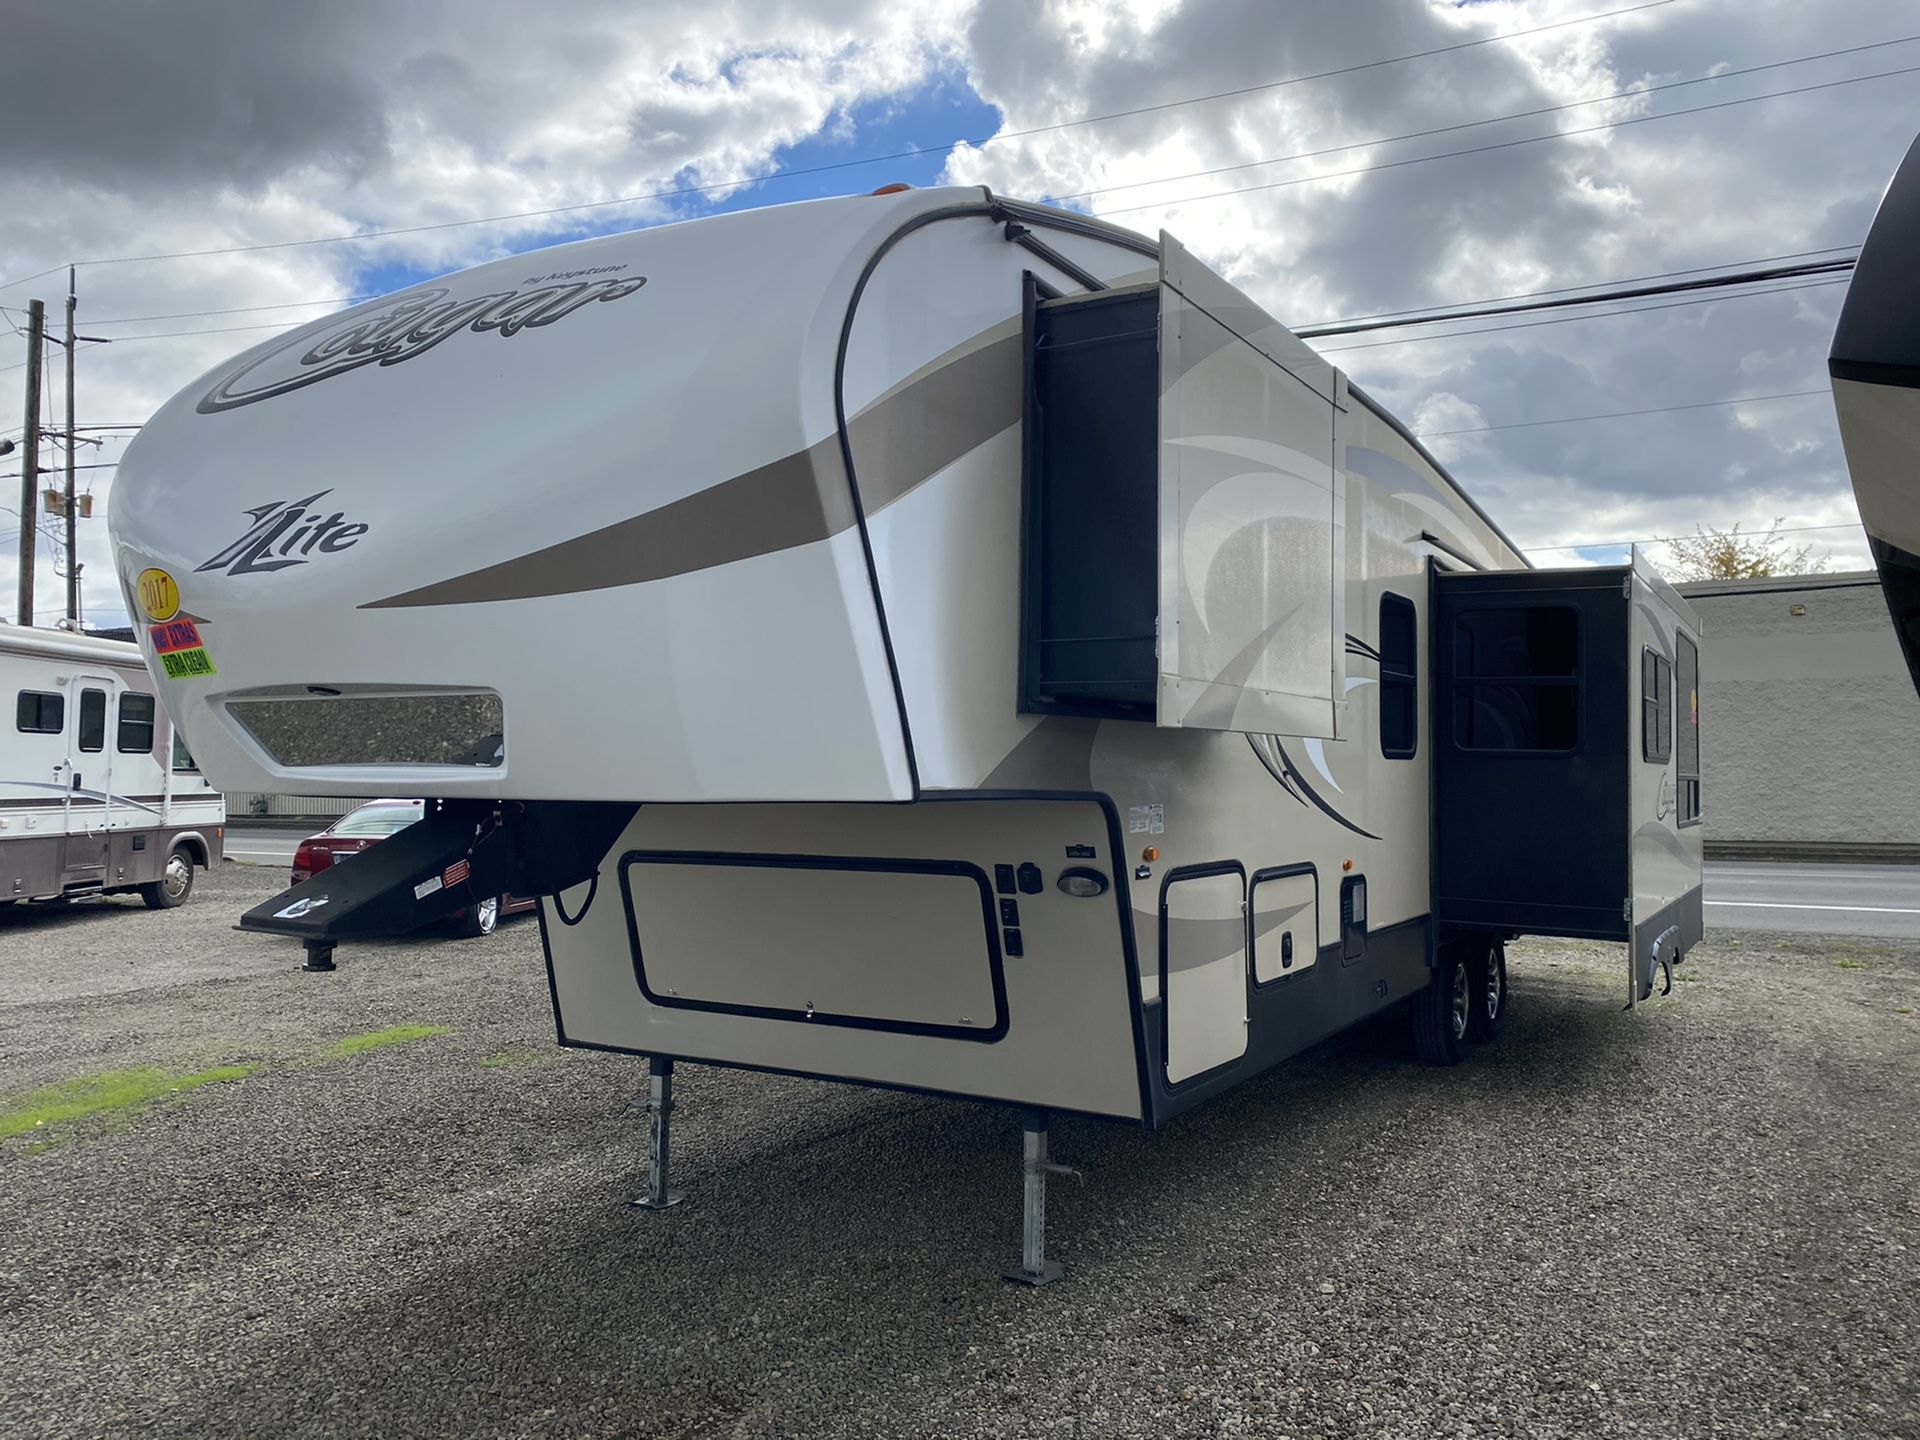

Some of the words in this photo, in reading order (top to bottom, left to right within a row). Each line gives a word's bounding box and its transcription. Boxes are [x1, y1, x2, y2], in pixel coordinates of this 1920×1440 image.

[196, 276, 647, 414] Cougar
[143, 576, 169, 612] 2017
[161, 653, 189, 676] EXTRA
[182, 649, 213, 673] CLEAN
